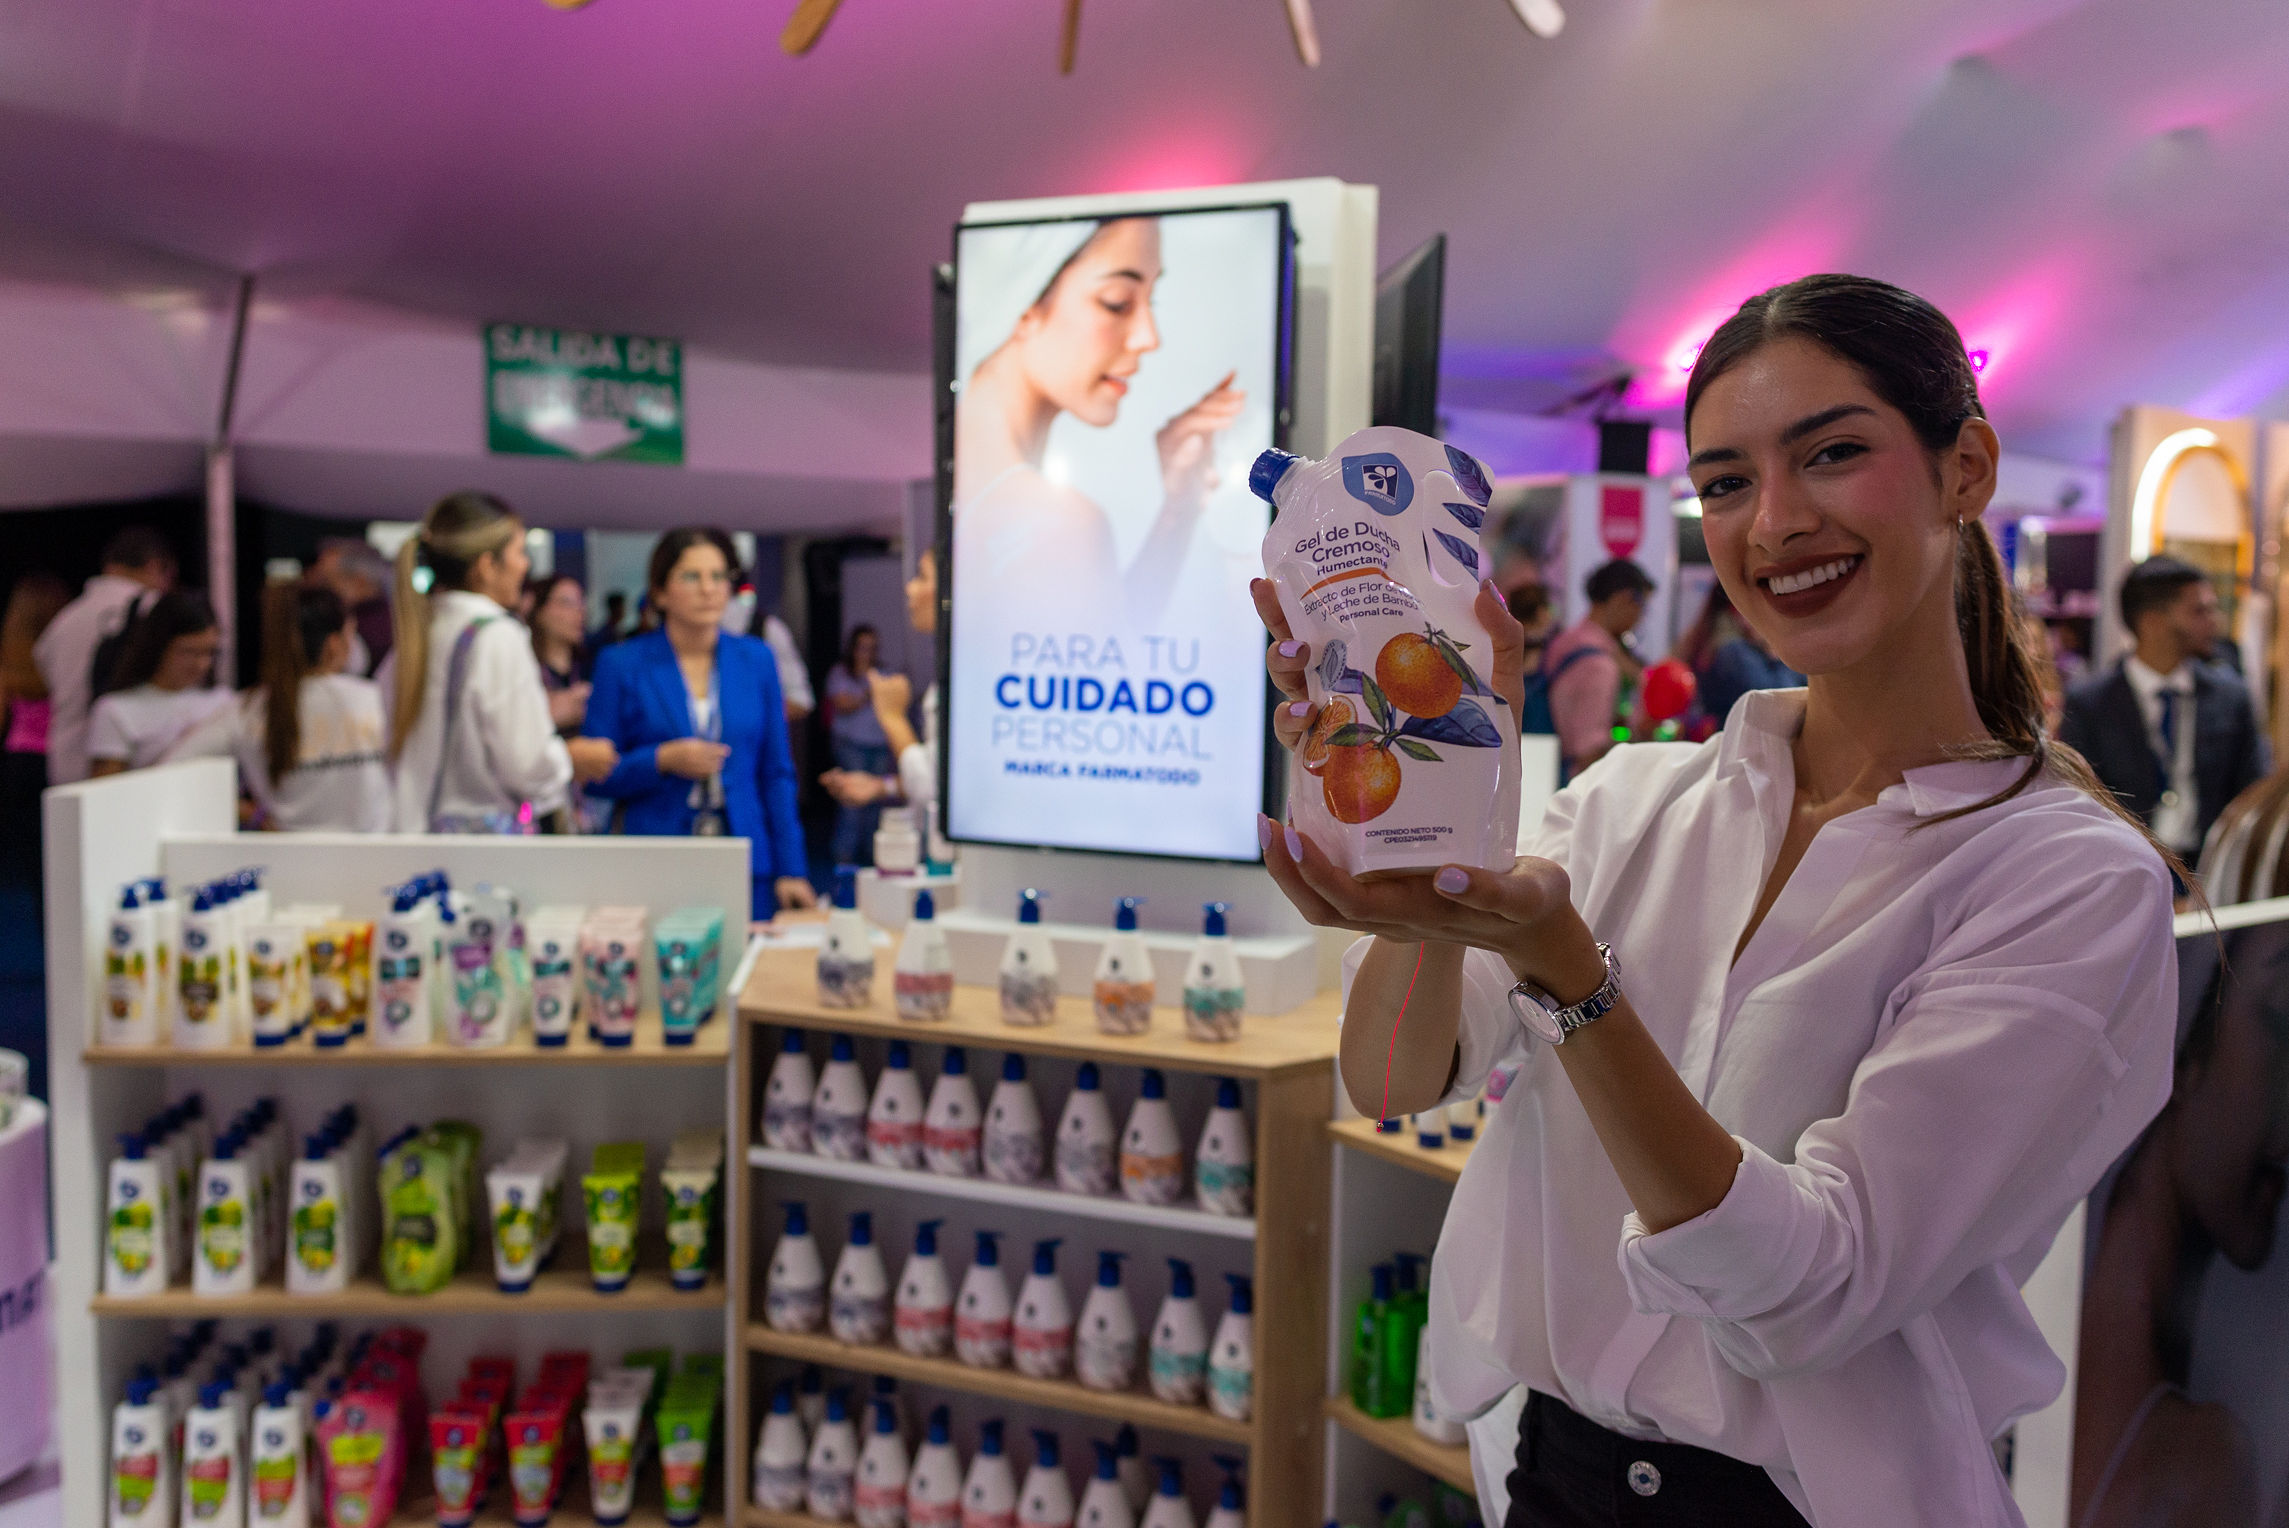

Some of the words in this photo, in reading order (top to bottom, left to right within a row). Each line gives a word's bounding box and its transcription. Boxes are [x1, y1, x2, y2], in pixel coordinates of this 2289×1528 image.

[1295, 531, 1321, 553] Gel
[1325, 526, 1350, 542] de
[1354, 521, 1401, 552] Ducha
[1312, 540, 1390, 563] Cremoso
[1303, 590, 1339, 616] Extracto
[1340, 586, 1357, 597] de
[1359, 582, 1383, 593] Flor
[1321, 610, 1327, 622] y
[1327, 598, 1361, 616] Leche
[1363, 594, 1380, 604] de
[1339, 608, 1381, 623] Personal
[1381, 607, 1404, 617] Care
[1010, 631, 1128, 671] PARA
[1141, 634, 1202, 675] TU
[995, 674, 1215, 717] CUIDADO
[990, 715, 1214, 761] PERSONAL
[1004, 759, 1071, 779] MARCA
[1077, 761, 1202, 787] FARMATODO
[1365, 828, 1409, 837] CONTENIDO
[1432, 826, 1447, 834] 500
